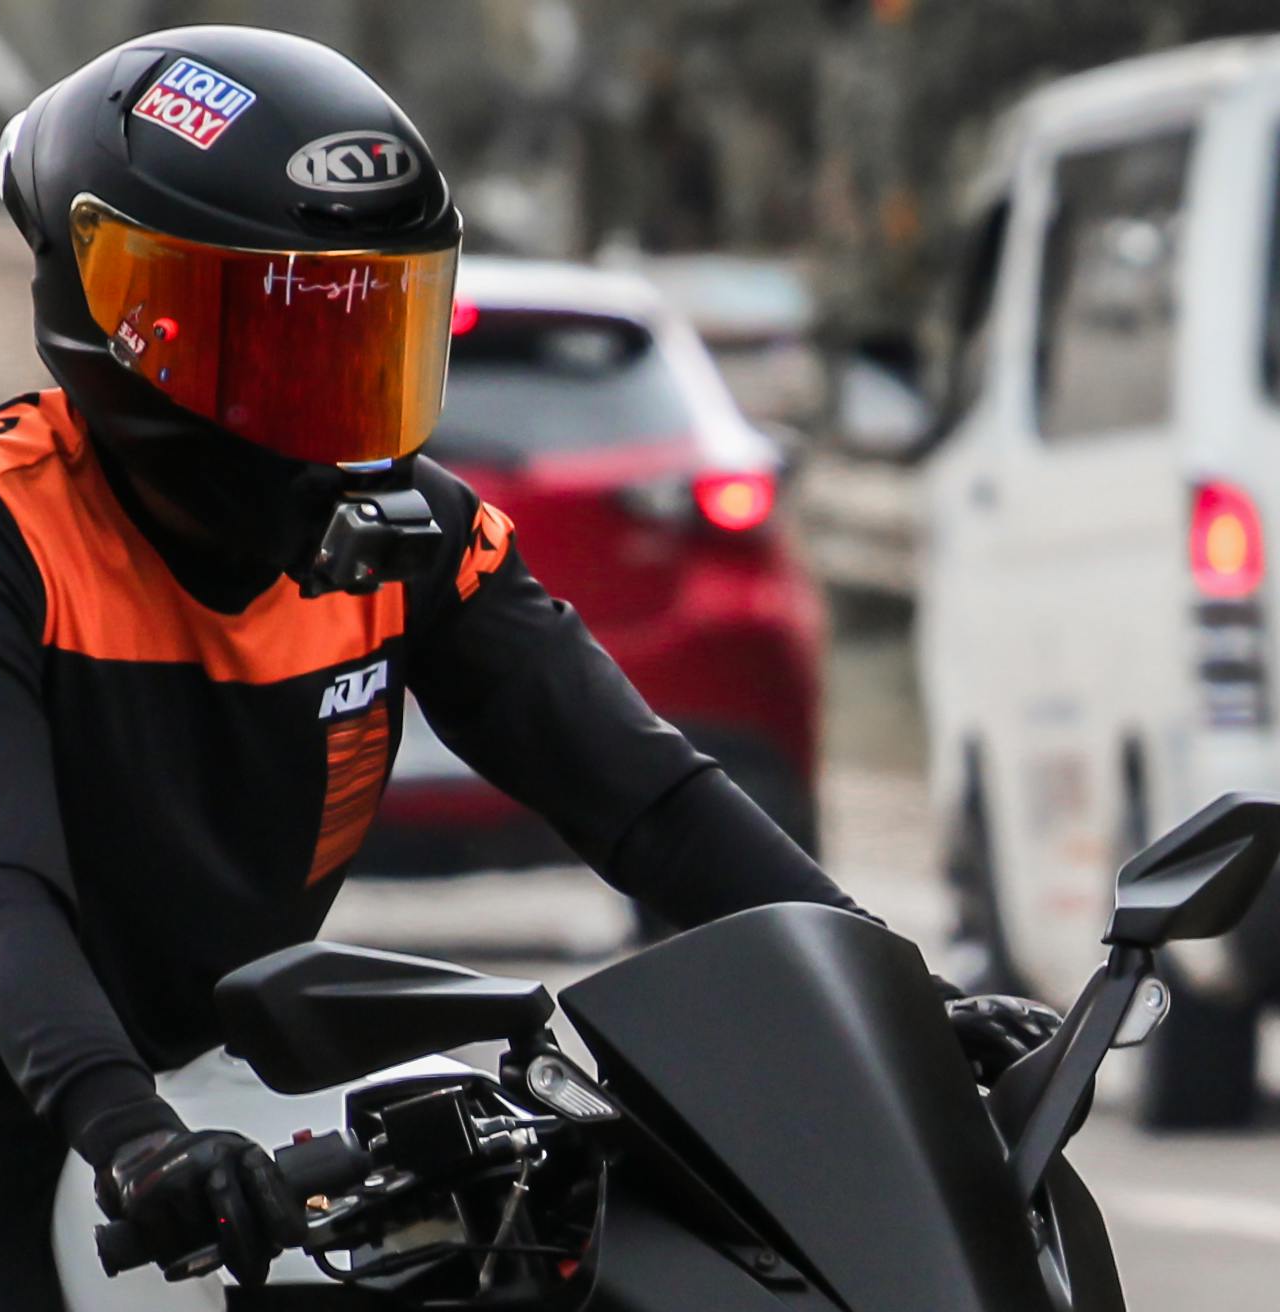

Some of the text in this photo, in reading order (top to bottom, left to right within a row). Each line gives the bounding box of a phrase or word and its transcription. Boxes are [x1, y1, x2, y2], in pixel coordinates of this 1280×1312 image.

[139, 88, 225, 139] MOLY
[162, 63, 247, 117] LIQUI
[303, 143, 407, 183] KYT
[318, 659, 387, 719] KTM
